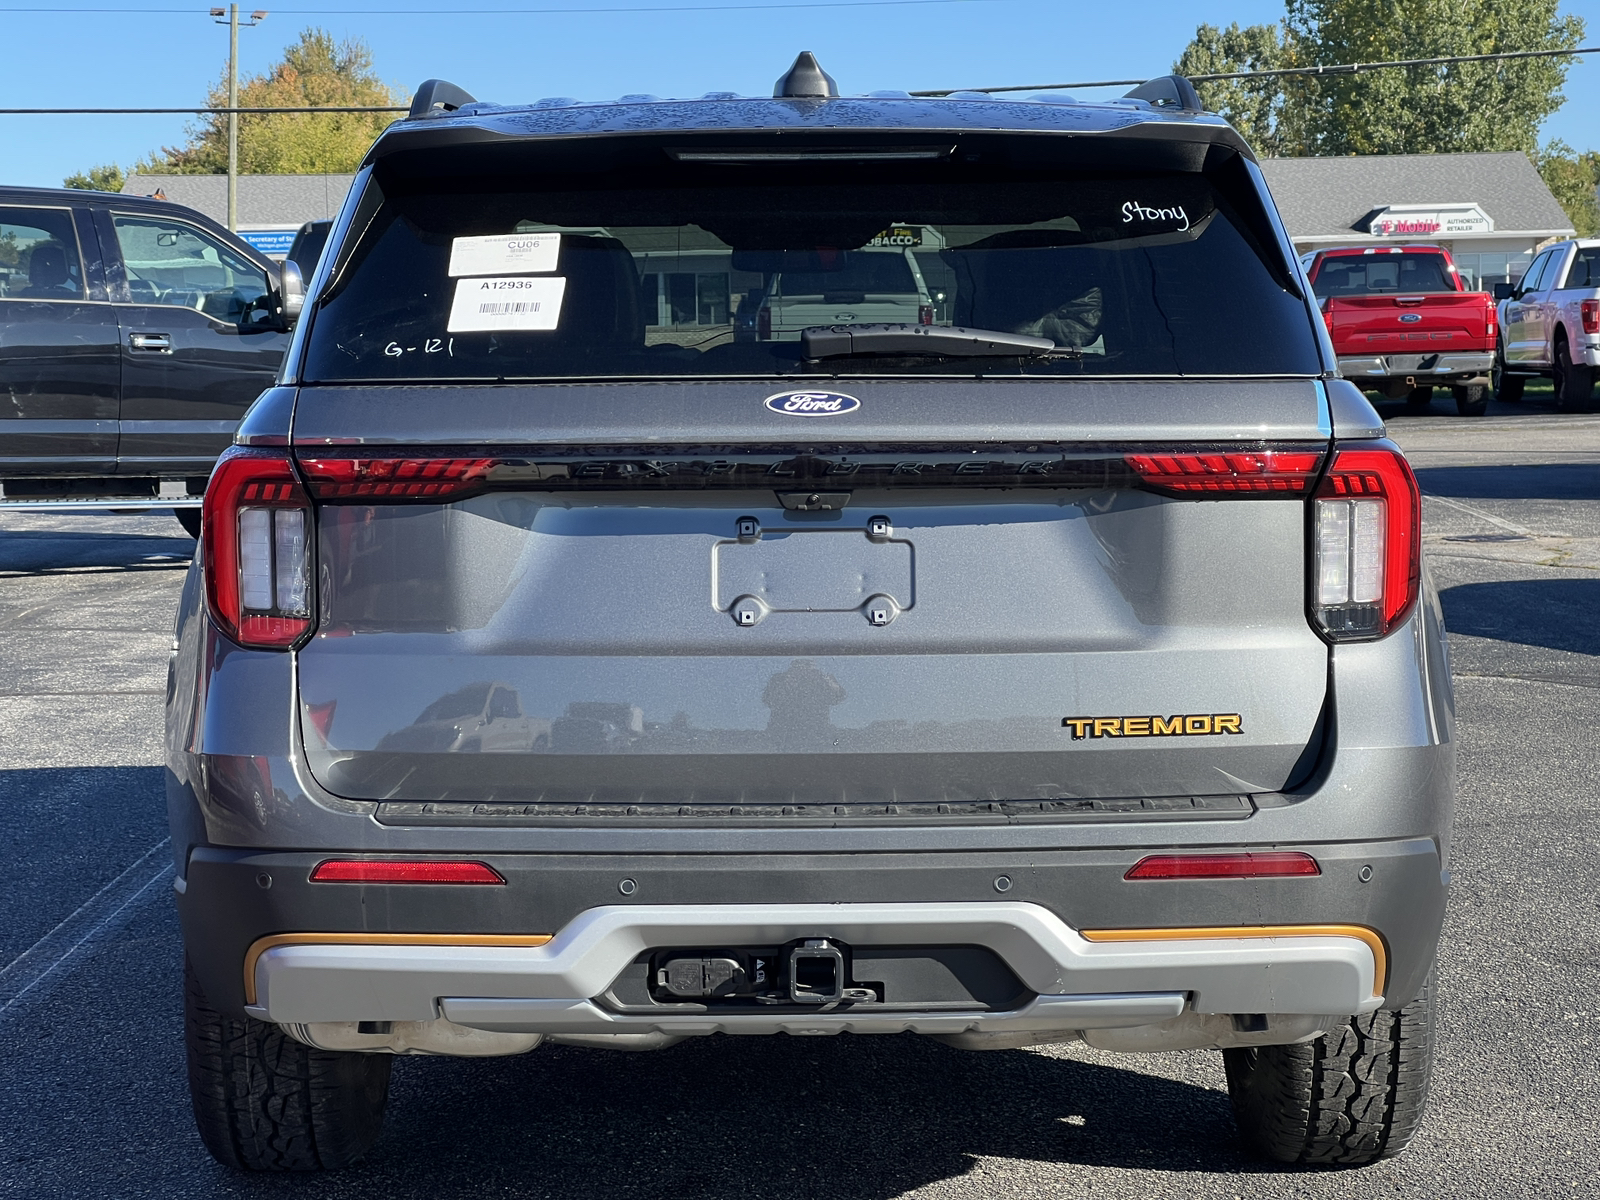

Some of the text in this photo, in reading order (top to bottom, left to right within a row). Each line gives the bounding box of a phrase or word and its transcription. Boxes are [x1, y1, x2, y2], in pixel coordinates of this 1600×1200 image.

[1122, 201, 1189, 231] Stony
[1396, 219, 1441, 233] Mobile
[507, 240, 540, 249] CU06
[866, 236, 913, 247] OBACCO
[480, 281, 532, 290] A12936
[784, 394, 843, 411] Ford
[575, 461, 1053, 477] EXPLORER
[1062, 713, 1244, 740] TREMOR
